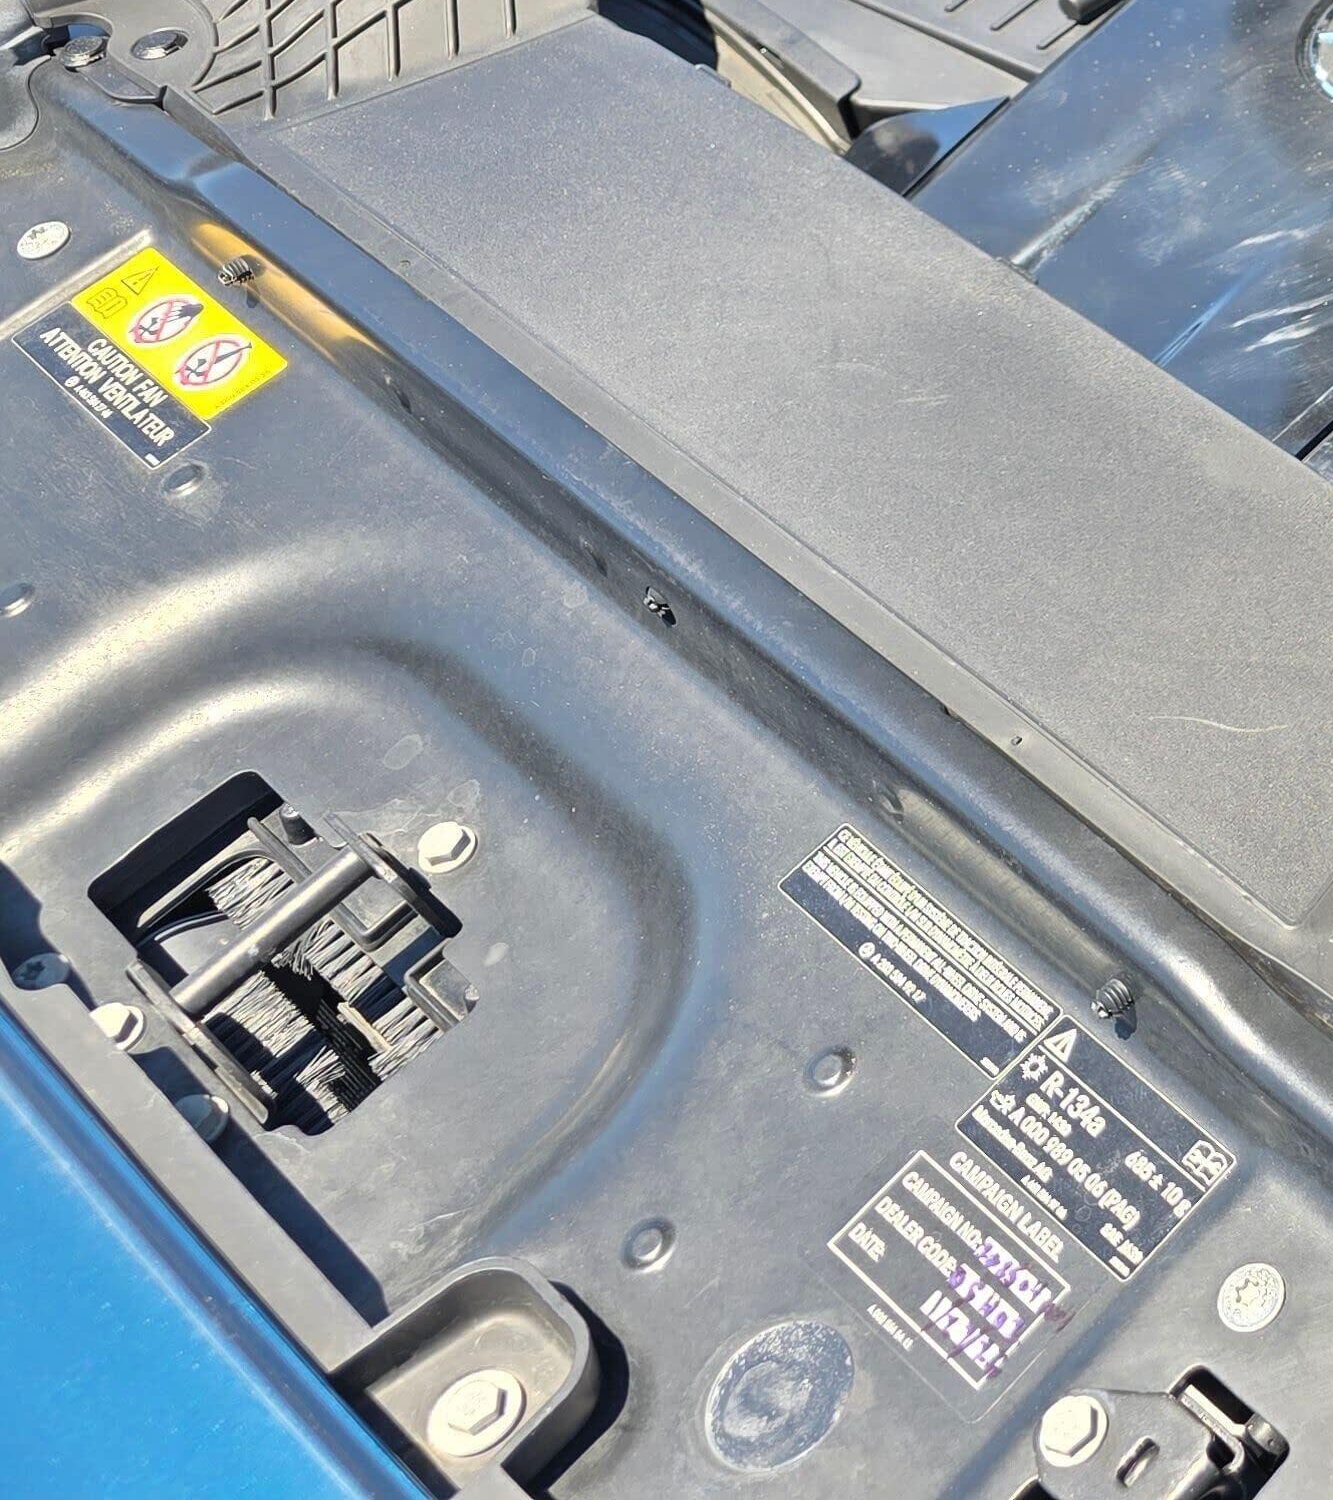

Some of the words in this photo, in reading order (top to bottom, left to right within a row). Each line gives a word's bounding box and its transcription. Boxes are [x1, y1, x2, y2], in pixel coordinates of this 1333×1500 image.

[39, 327, 106, 383] ATTENTION
[98, 377, 174, 446] VENTILATEUR
[87, 338, 142, 385] CAUTION
[132, 378, 168, 407] FAN
[1039, 1070, 1105, 1137] R-134a
[1007, 1106, 1025, 1126] A
[1019, 1115, 1049, 1145] 000
[1042, 1136, 1073, 1165] 989
[1067, 1157, 1090, 1182] 05
[1084, 1173, 1107, 1197] 06
[874, 1196, 923, 1246] DEALER
[917, 1236, 956, 1277] CODE:
[902, 1171, 963, 1230] CAMPAIGN
[949, 1151, 1023, 1222] CAMPAIGN
[1016, 1212, 1063, 1262] LABEL
[848, 1222, 884, 1262] DATE:
